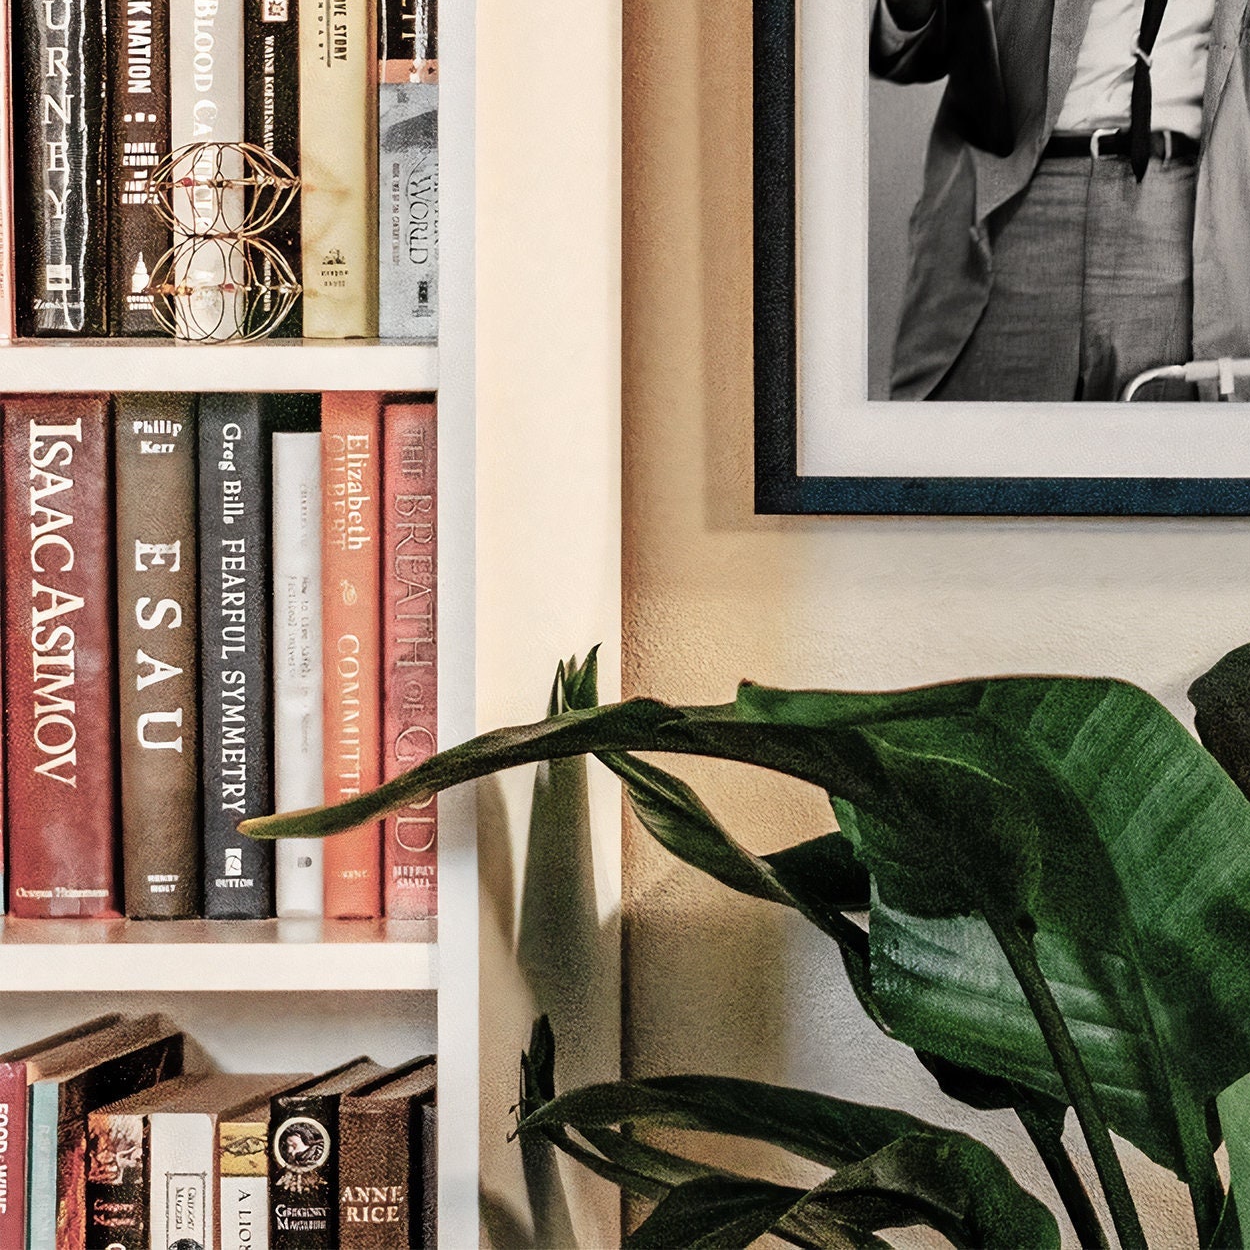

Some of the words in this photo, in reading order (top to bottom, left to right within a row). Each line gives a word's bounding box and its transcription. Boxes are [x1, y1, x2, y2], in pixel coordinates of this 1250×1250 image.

[127, 20, 152, 94] NATION
[333, 24, 347, 62] STORY
[133, 420, 182, 437] Philip
[140, 440, 175, 454] Kerr
[218, 423, 242, 471] Greg
[402, 427, 425, 477] THE
[29, 418, 83, 572] ISAAC
[223, 480, 244, 524] Bills
[347, 433, 371, 551] Elizabeth
[221, 538, 246, 659] FEARFUL
[394, 494, 435, 668] BREATH
[135, 539, 184, 753] ESAU
[32, 580, 86, 788] ASIMOV
[221, 670, 246, 815] SYMMETRY
[341, 1186, 402, 1202] ANNE
[347, 1205, 399, 1223] RICE
